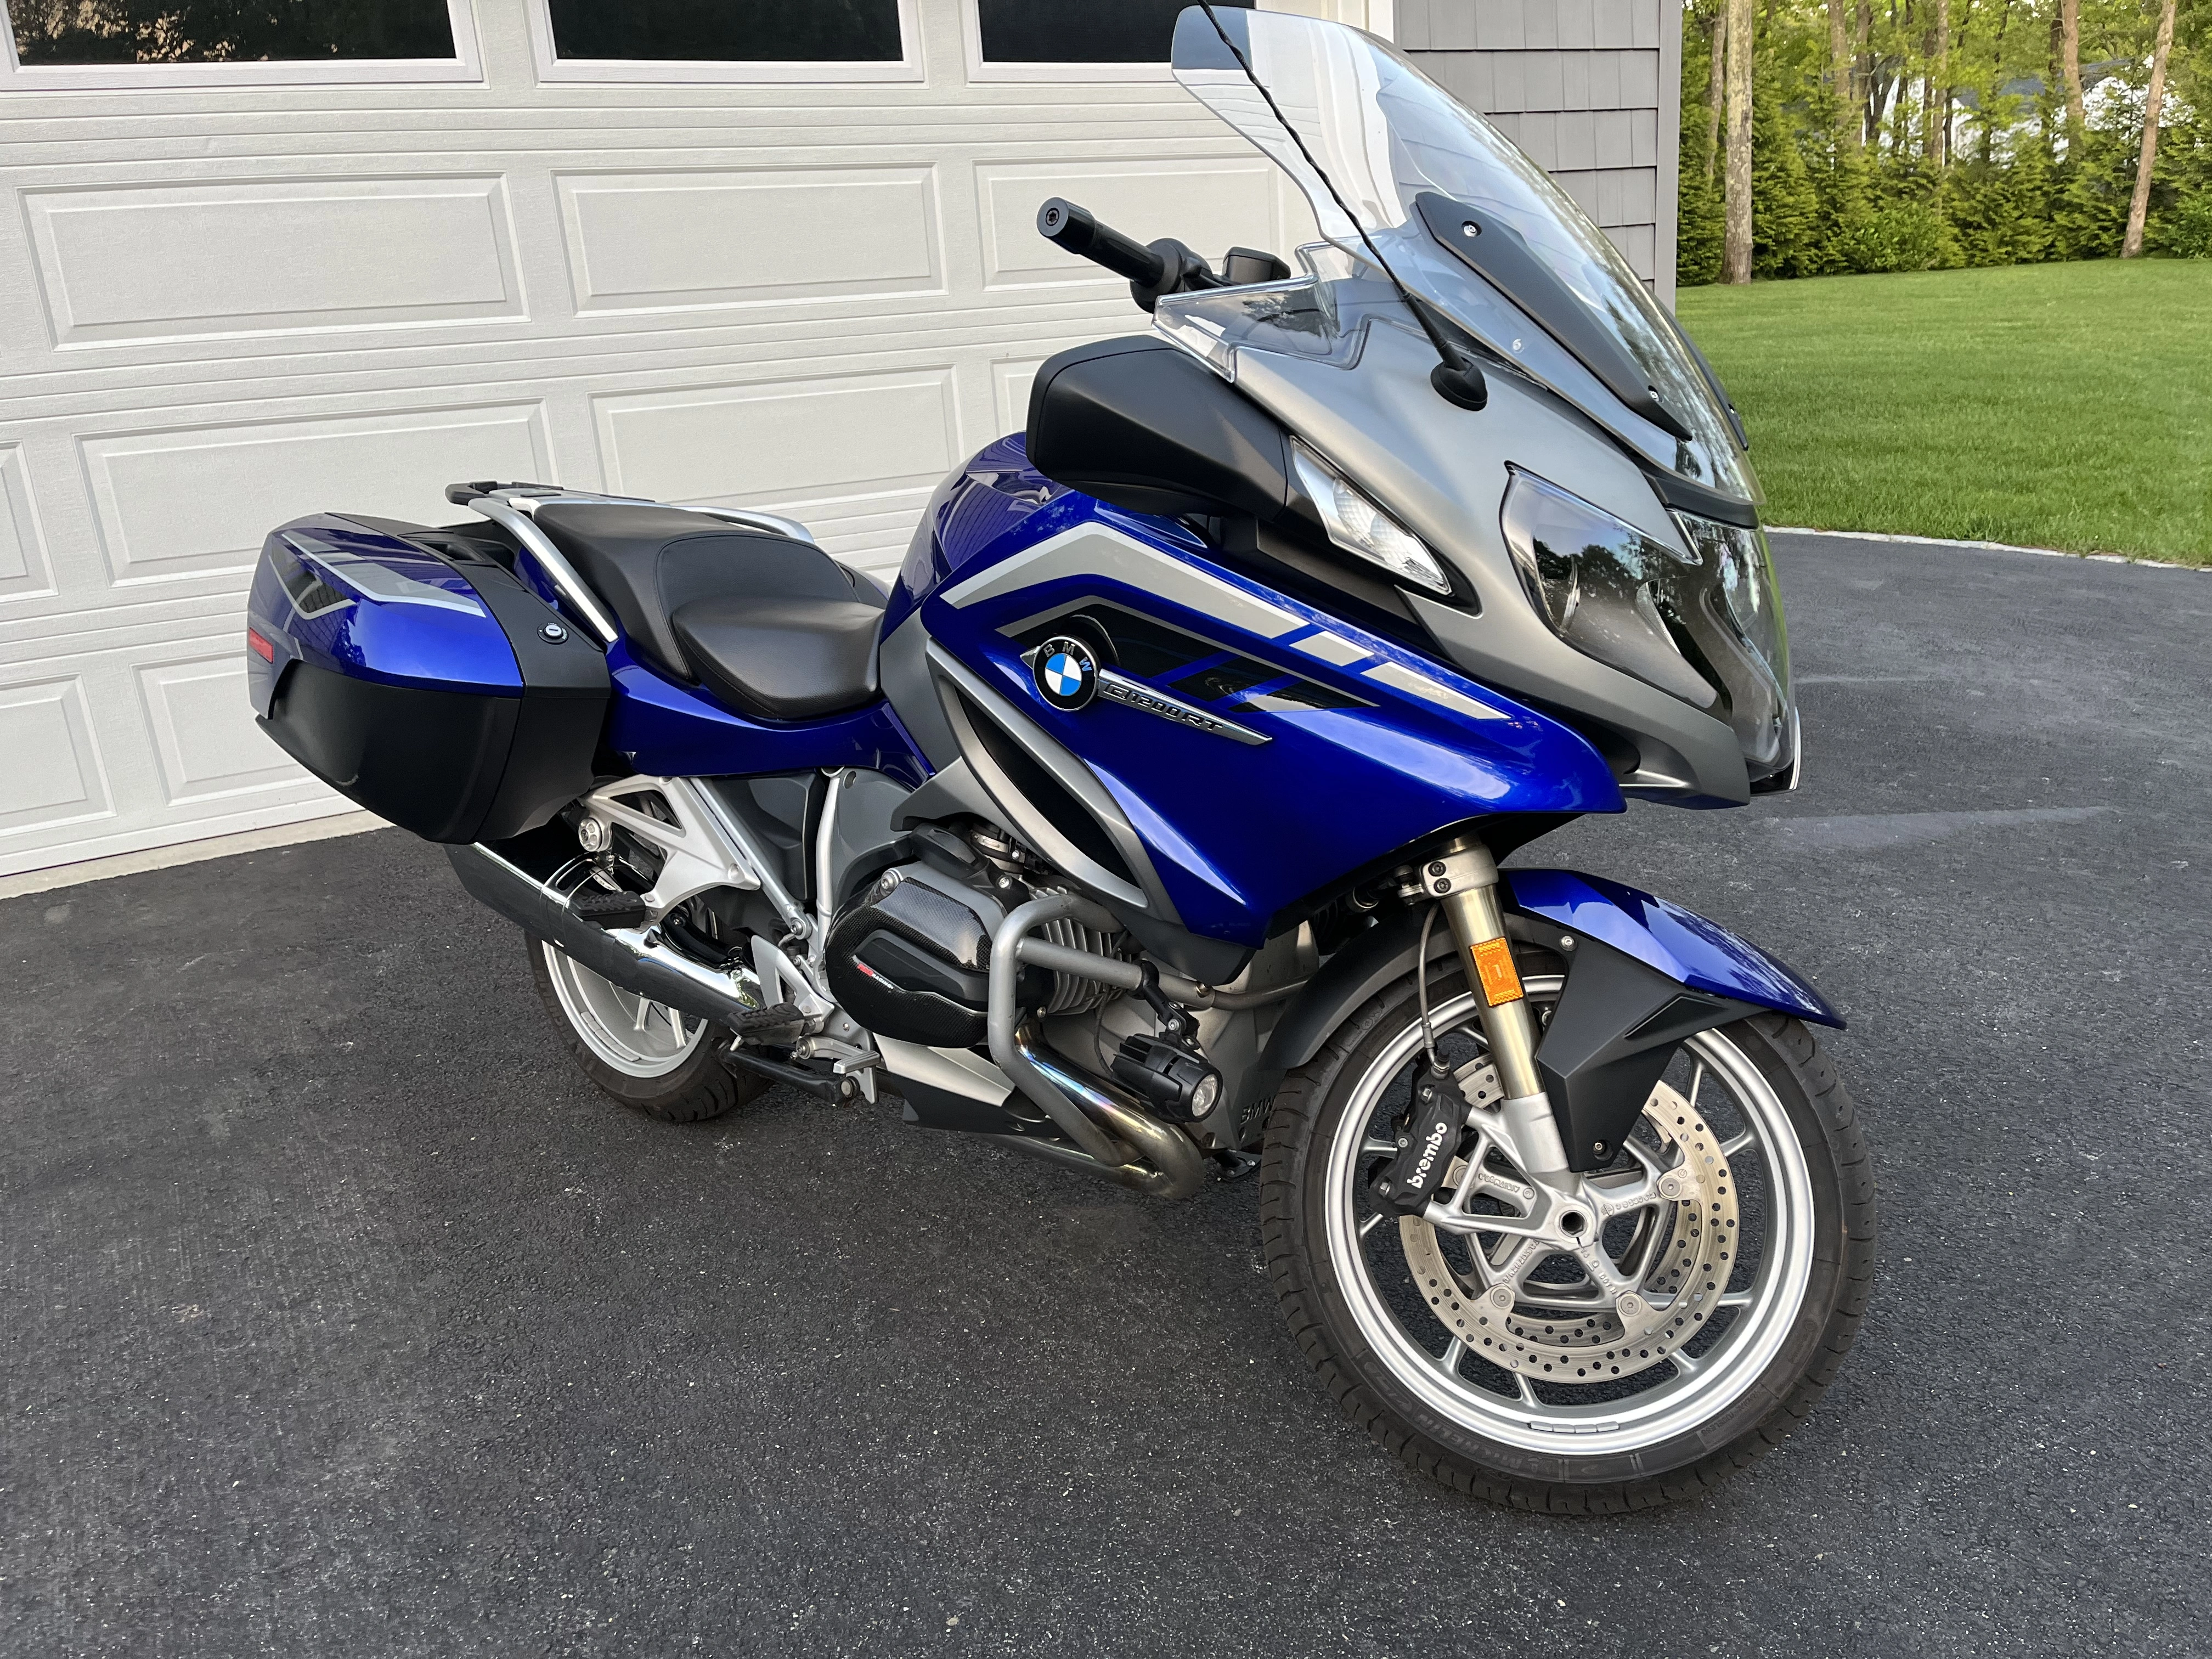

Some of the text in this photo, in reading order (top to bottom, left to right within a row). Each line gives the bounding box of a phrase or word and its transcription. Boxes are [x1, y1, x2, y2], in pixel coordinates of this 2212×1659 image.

[1043, 641, 1092, 672] BMW
[1240, 1096, 1274, 1125] BMW
[1407, 1122, 1447, 1189] brembo
